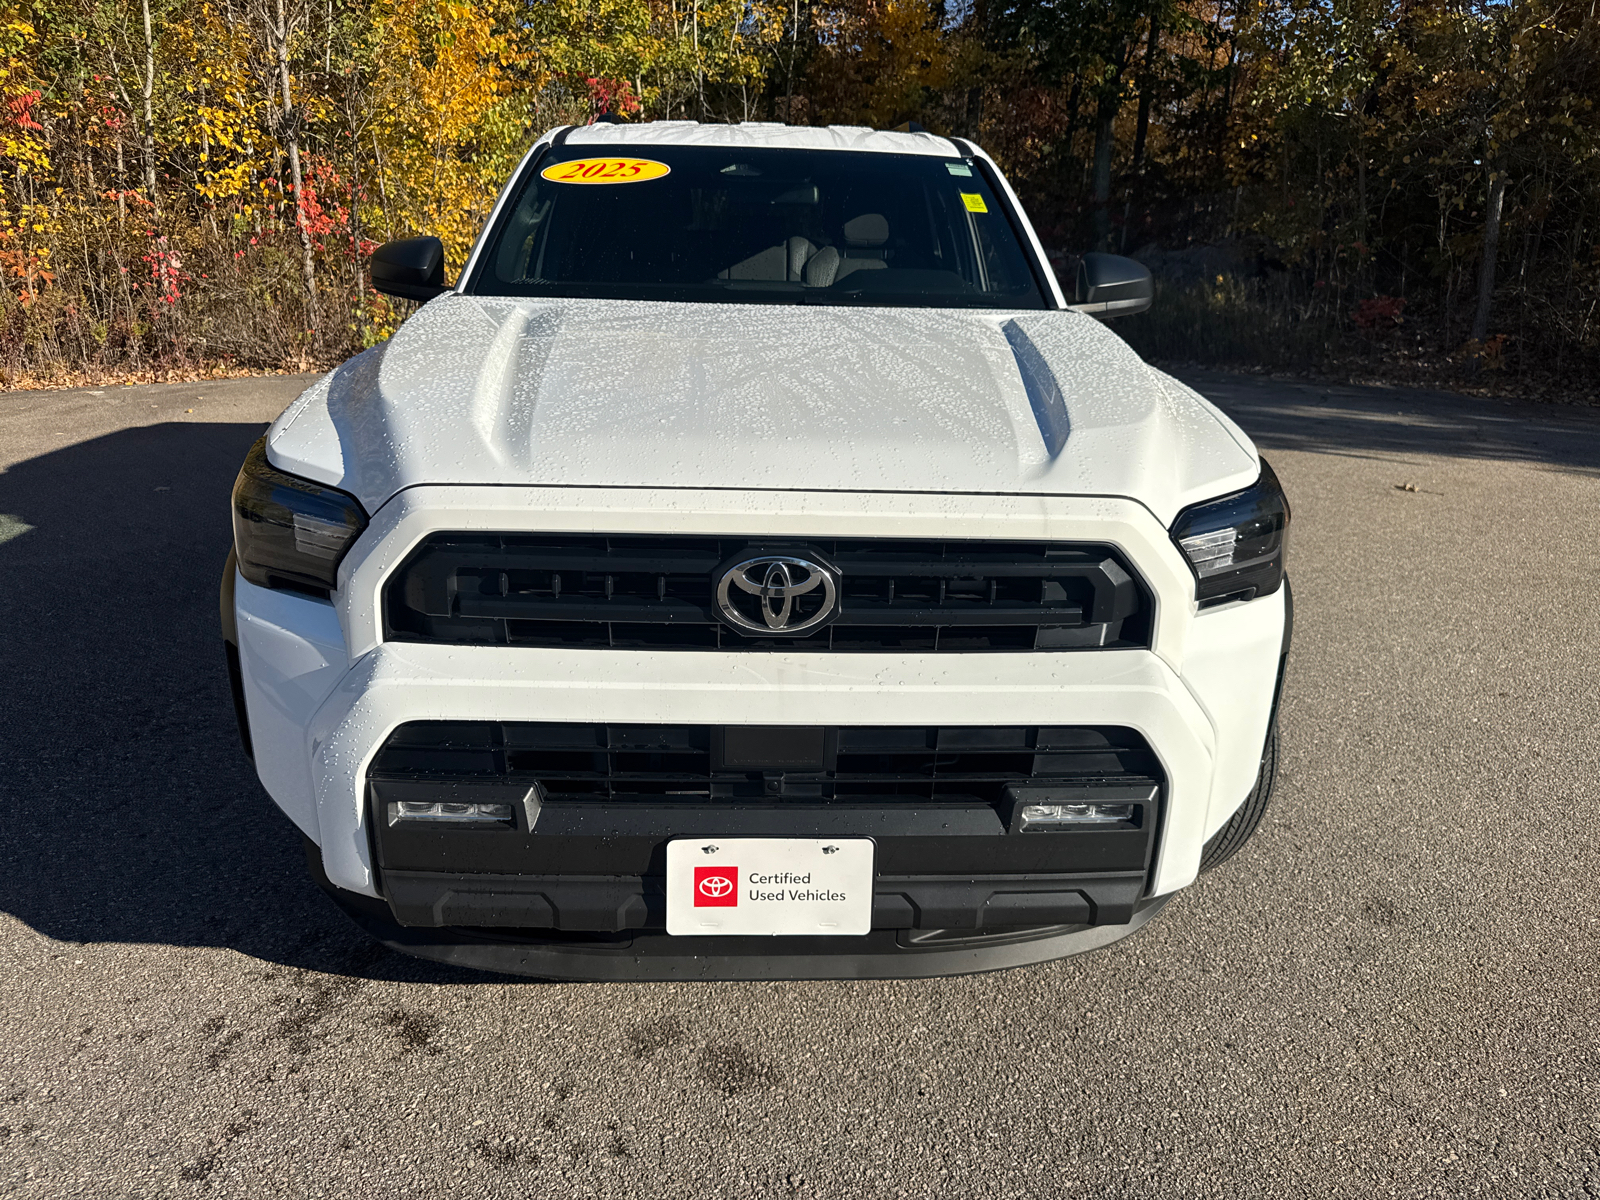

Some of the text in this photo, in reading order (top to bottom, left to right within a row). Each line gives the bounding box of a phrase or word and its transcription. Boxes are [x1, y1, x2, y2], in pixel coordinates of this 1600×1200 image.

[558, 162, 649, 179] 2025
[749, 872, 811, 884] Certified
[749, 889, 846, 901] Used Vehicles
